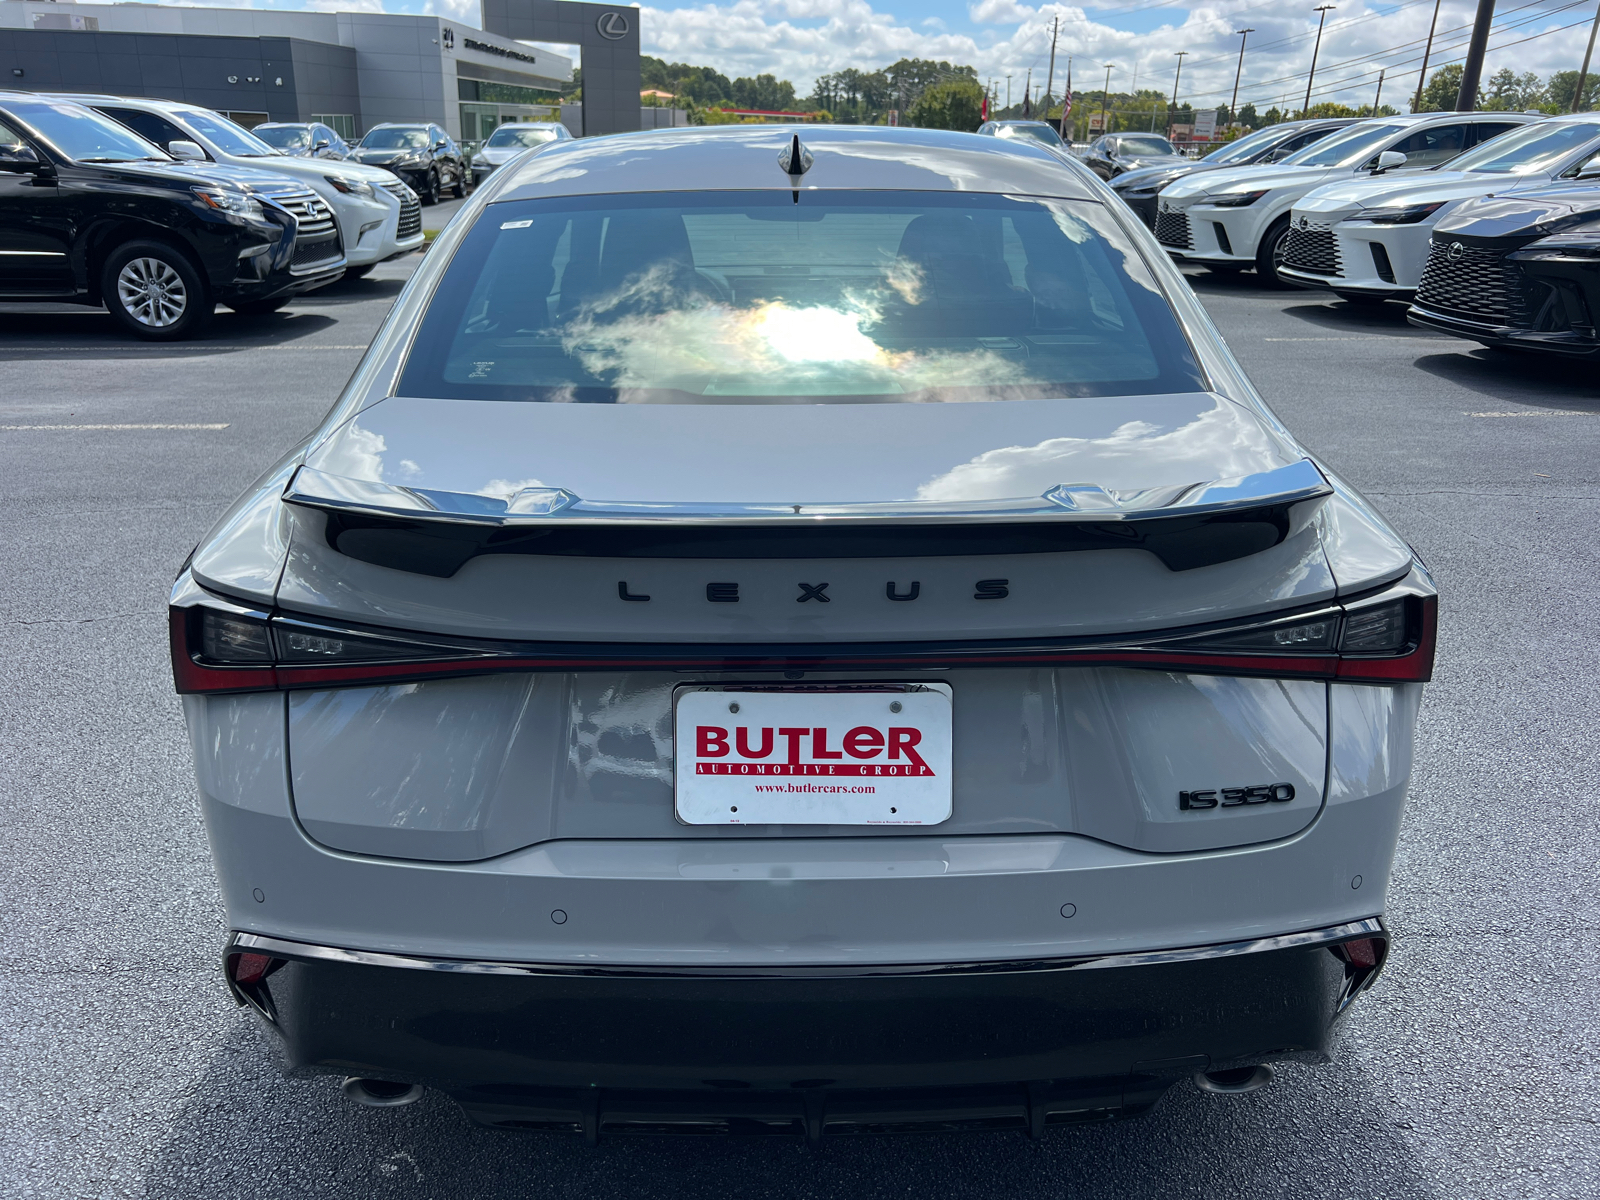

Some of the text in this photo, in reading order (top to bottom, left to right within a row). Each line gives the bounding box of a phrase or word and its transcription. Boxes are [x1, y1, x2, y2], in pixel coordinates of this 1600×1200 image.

[617, 579, 1010, 603] LEXUS
[697, 764, 927, 776] AUTOMOTIVE GROUP
[755, 783, 876, 794] www.butlercars.com
[1179, 782, 1296, 811] IS 350
